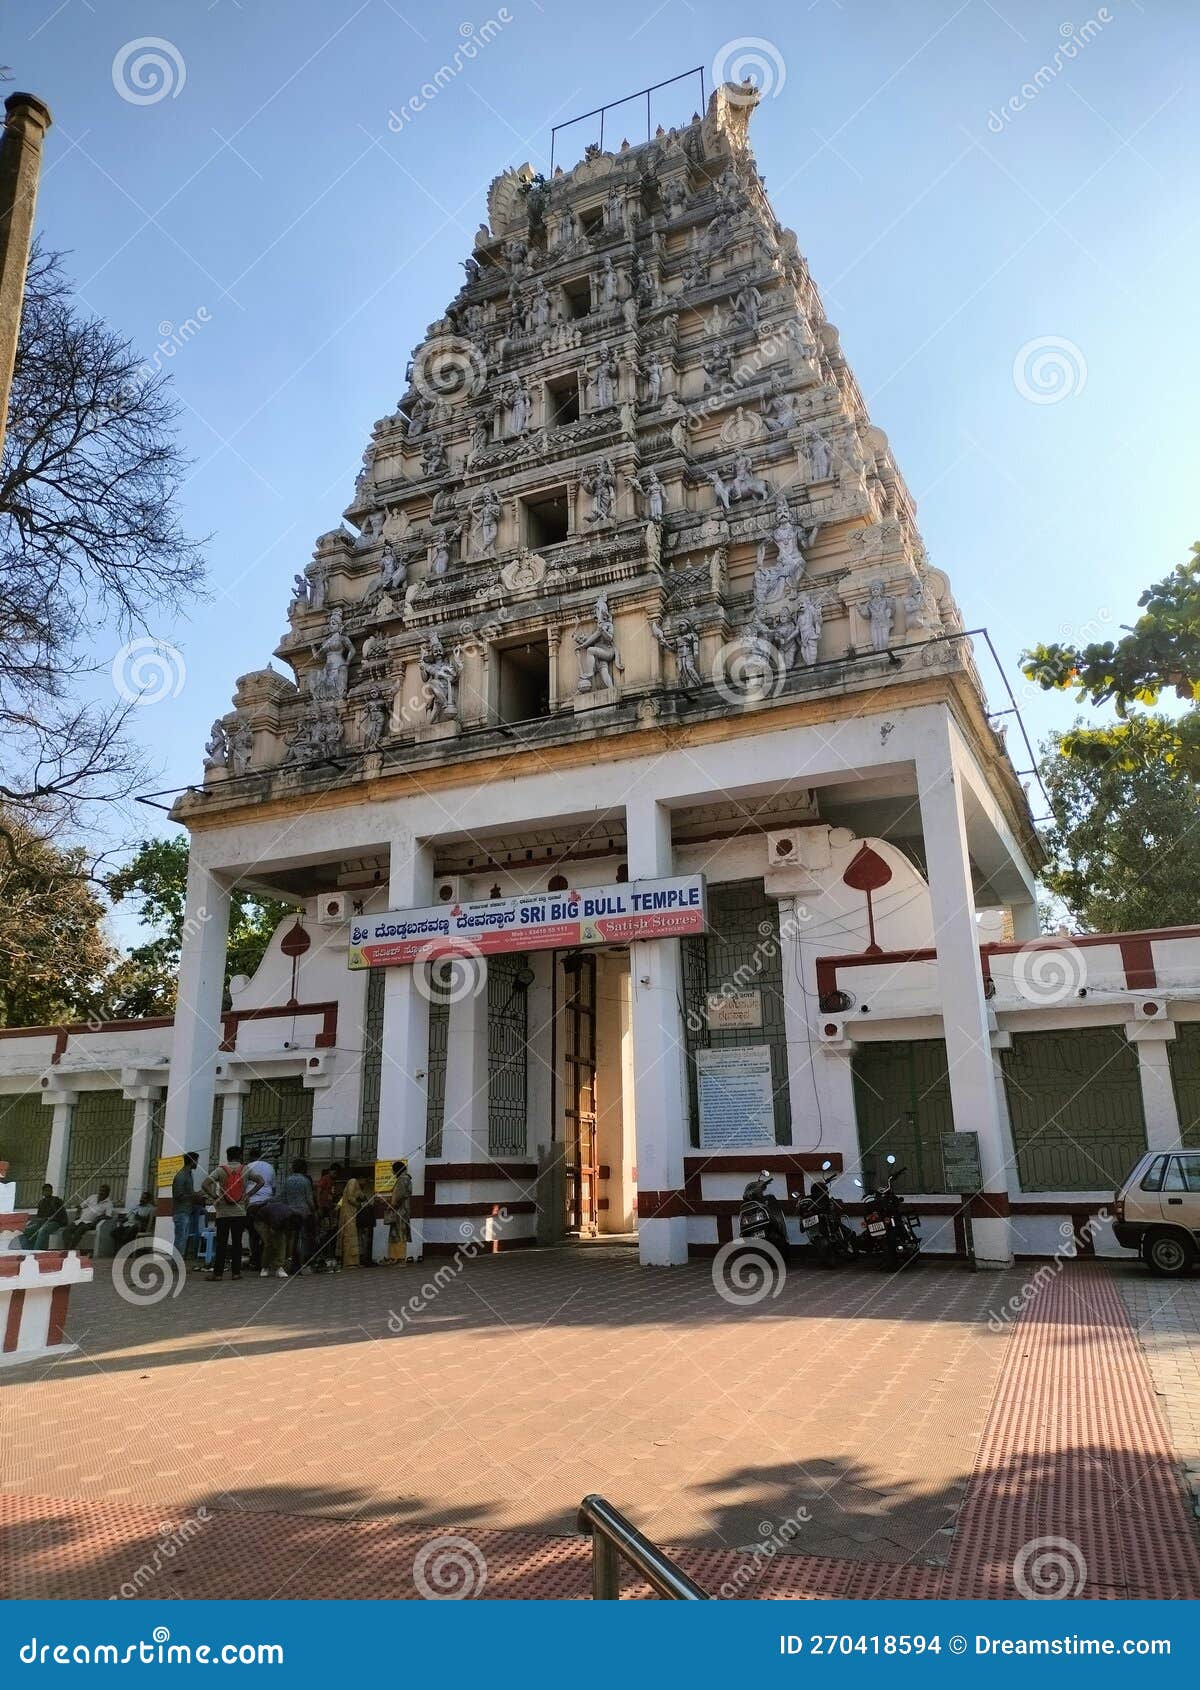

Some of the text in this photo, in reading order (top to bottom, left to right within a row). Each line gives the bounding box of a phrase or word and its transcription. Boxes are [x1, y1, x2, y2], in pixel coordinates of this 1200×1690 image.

[520, 905, 545, 924] SRI
[551, 901, 579, 921] BIG
[584, 896, 626, 917] BULL
[631, 887, 699, 911] TEMPLE
[352, 927, 368, 945] ಶ್ರೀ
[375, 917, 449, 939] ದೊಡ್ಡಬಸವಣ್ಣ
[606, 913, 697, 932] Satish Stores
